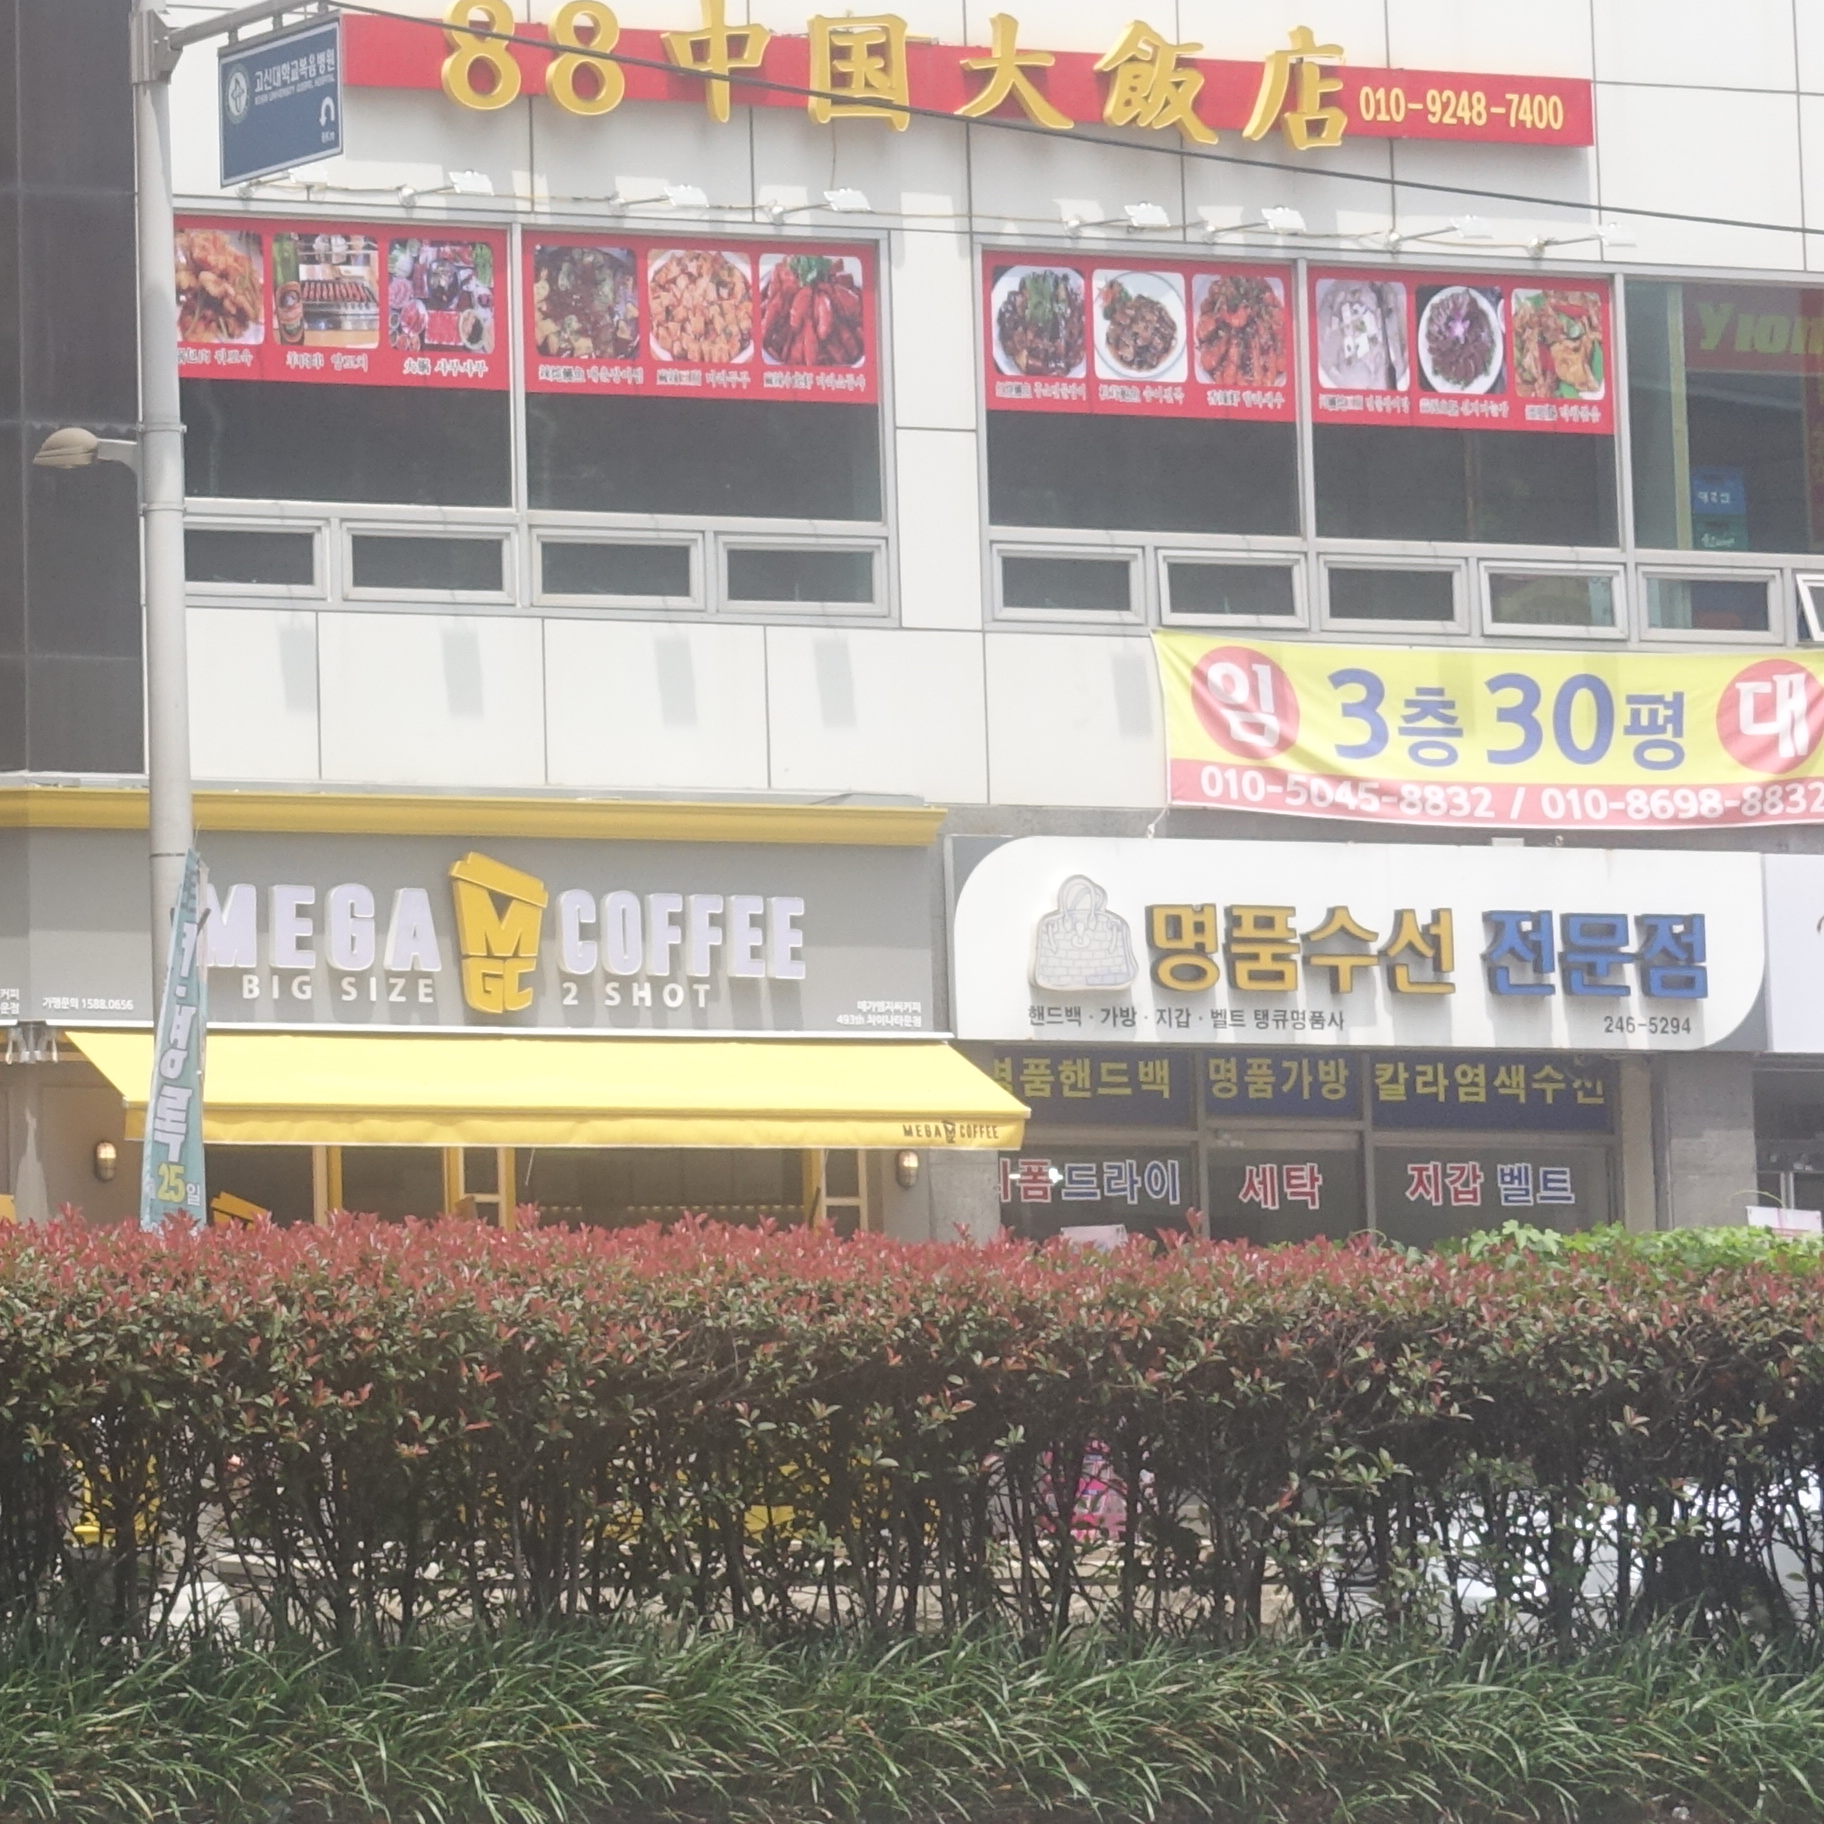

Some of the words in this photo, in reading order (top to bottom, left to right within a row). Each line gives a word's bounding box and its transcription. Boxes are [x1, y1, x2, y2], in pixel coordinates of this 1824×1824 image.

[1358, 83, 1565, 132] 010-9248-7400
[1207, 661, 1278, 749] 임
[1327, 668, 1464, 768] 3층
[1484, 672, 1686, 771] 30평
[1734, 673, 1810, 758] 대
[1200, 764, 1495, 819] 010-5045-8832
[205, 882, 442, 973] MEGA
[555, 888, 806, 980] COFFEE
[1145, 902, 1457, 996] 명품수선
[1483, 908, 1709, 1000] 전문점
[242, 974, 313, 1000] BIG
[341, 976, 434, 1004] SIZE
[562, 982, 579, 1006] 2
[604, 981, 711, 1009] SHOT
[1028, 1006, 1083, 1027] 핸드백
[1099, 1007, 1138, 1028] 가방
[1155, 1008, 1192, 1029] 지갑
[1210, 1009, 1247, 1030] 벨트
[1604, 1016, 1692, 1035] 246-5294
[1208, 1056, 1350, 1101] 명품가방
[903, 1123, 942, 1138] MEGA
[959, 1124, 1000, 1139] COFFEE
[1061, 1158, 1181, 1206] 드라이
[1238, 1162, 1324, 1211] 세탁
[1405, 1160, 1485, 1206] 지갑
[1496, 1161, 1576, 1207] 벨트
